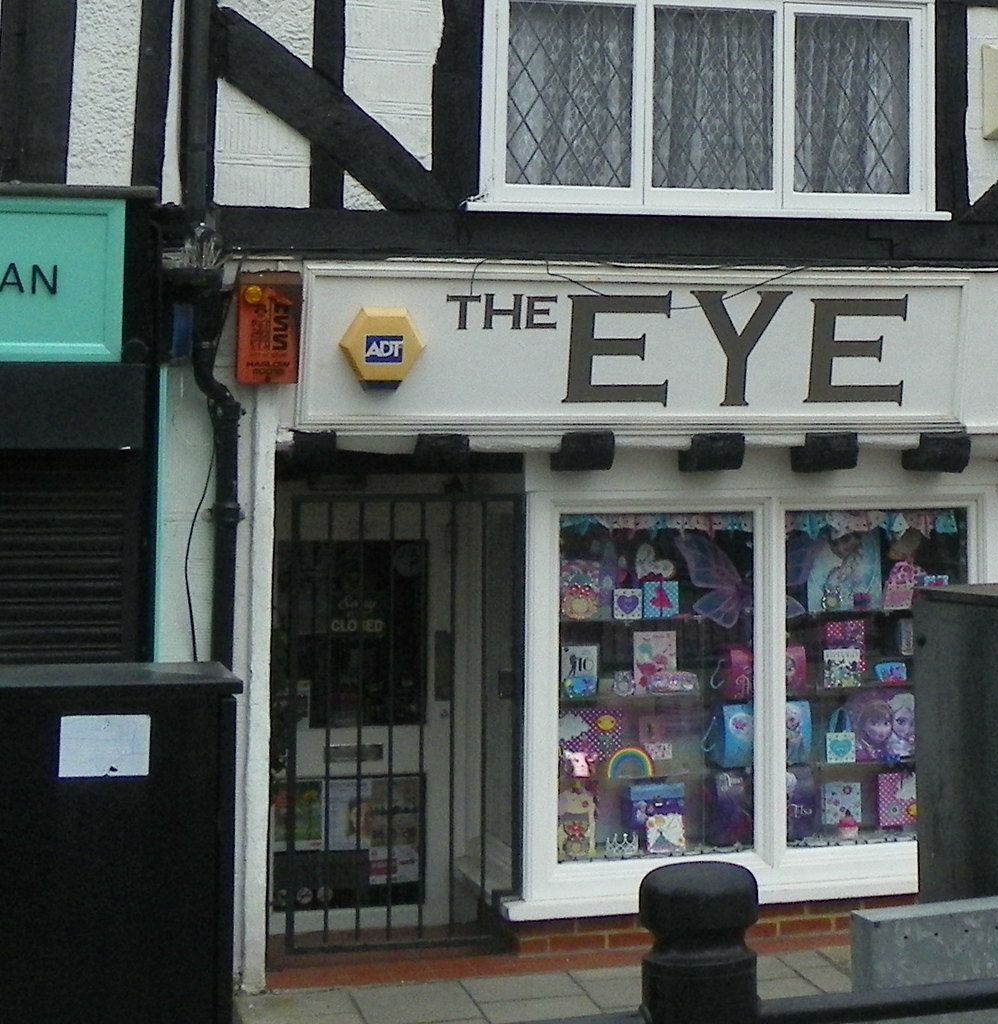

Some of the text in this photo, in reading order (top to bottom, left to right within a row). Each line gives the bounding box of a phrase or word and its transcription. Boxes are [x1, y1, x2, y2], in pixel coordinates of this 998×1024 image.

[0, 262, 58, 295] AN
[363, 340, 404, 358] ADT
[446, 290, 909, 407] THE EYE
